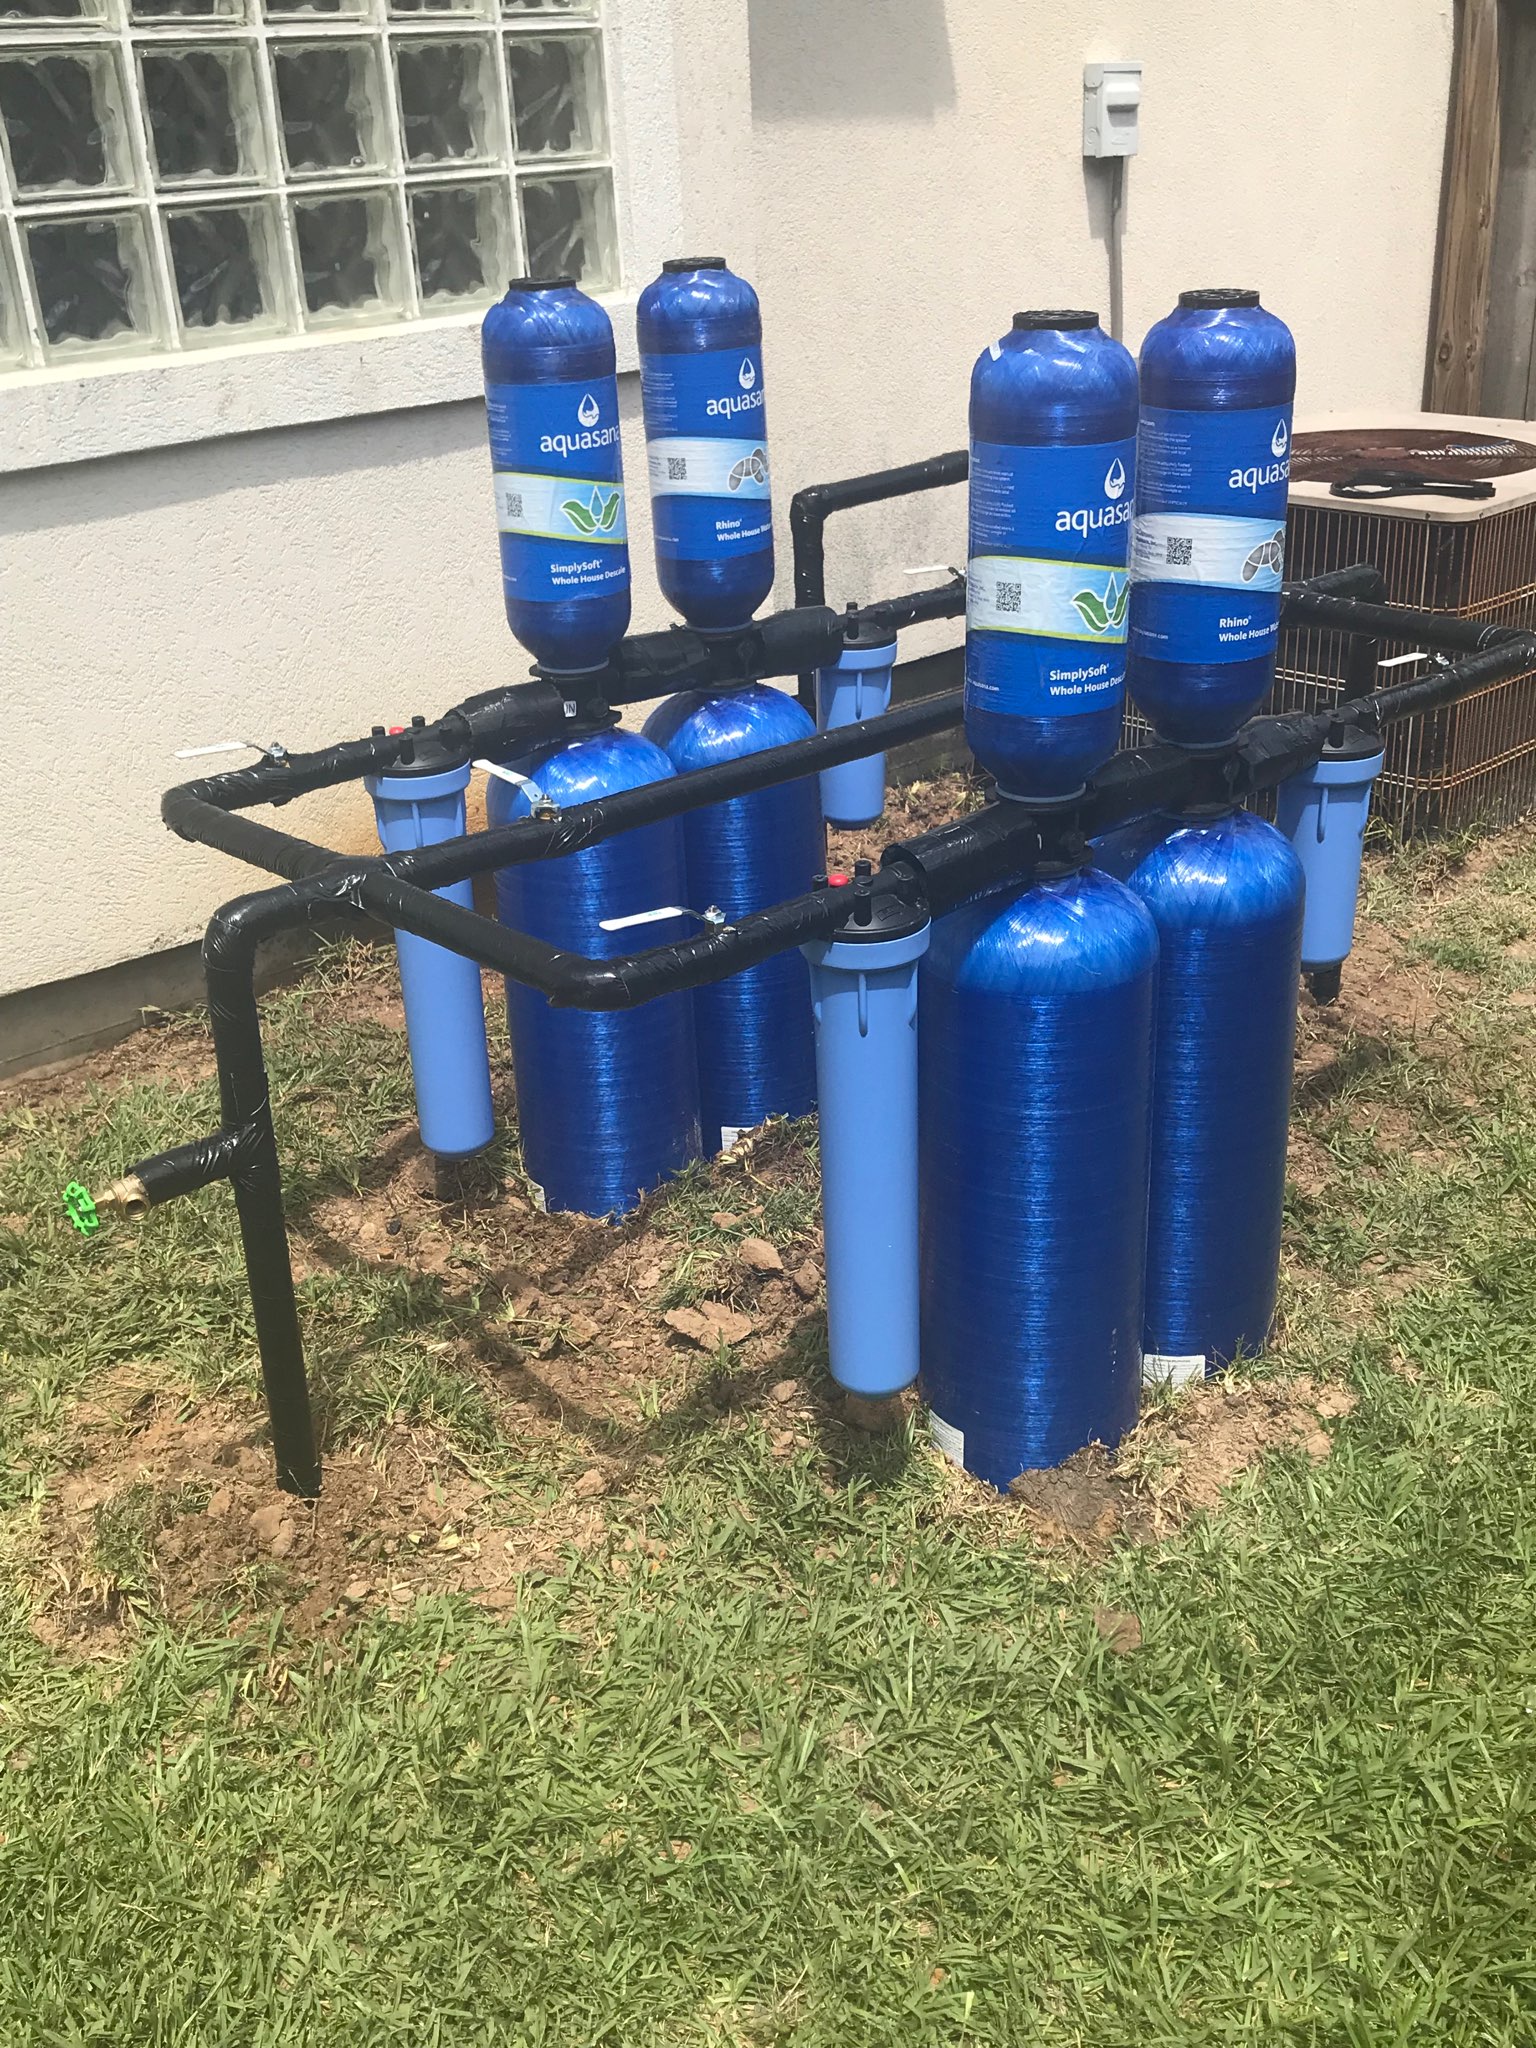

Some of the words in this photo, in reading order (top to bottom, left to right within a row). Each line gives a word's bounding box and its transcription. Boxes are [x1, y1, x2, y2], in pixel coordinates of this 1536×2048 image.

[706, 389, 764, 420] aquasa
[1228, 460, 1289, 494] aquasa
[715, 520, 741, 530] Rhino
[716, 531, 741, 541] Whole
[741, 528, 760, 538] House
[550, 559, 601, 574] SimplySoft
[551, 576, 579, 585] Whole
[580, 573, 604, 584] House
[604, 566, 626, 579] Descale
[1219, 617, 1249, 628] Rhino
[1218, 631, 1248, 642] Whole
[1248, 627, 1270, 639] House
[1049, 662, 1107, 682] SimplySoft
[1049, 684, 1083, 696] Whole
[1084, 680, 1110, 693] House
